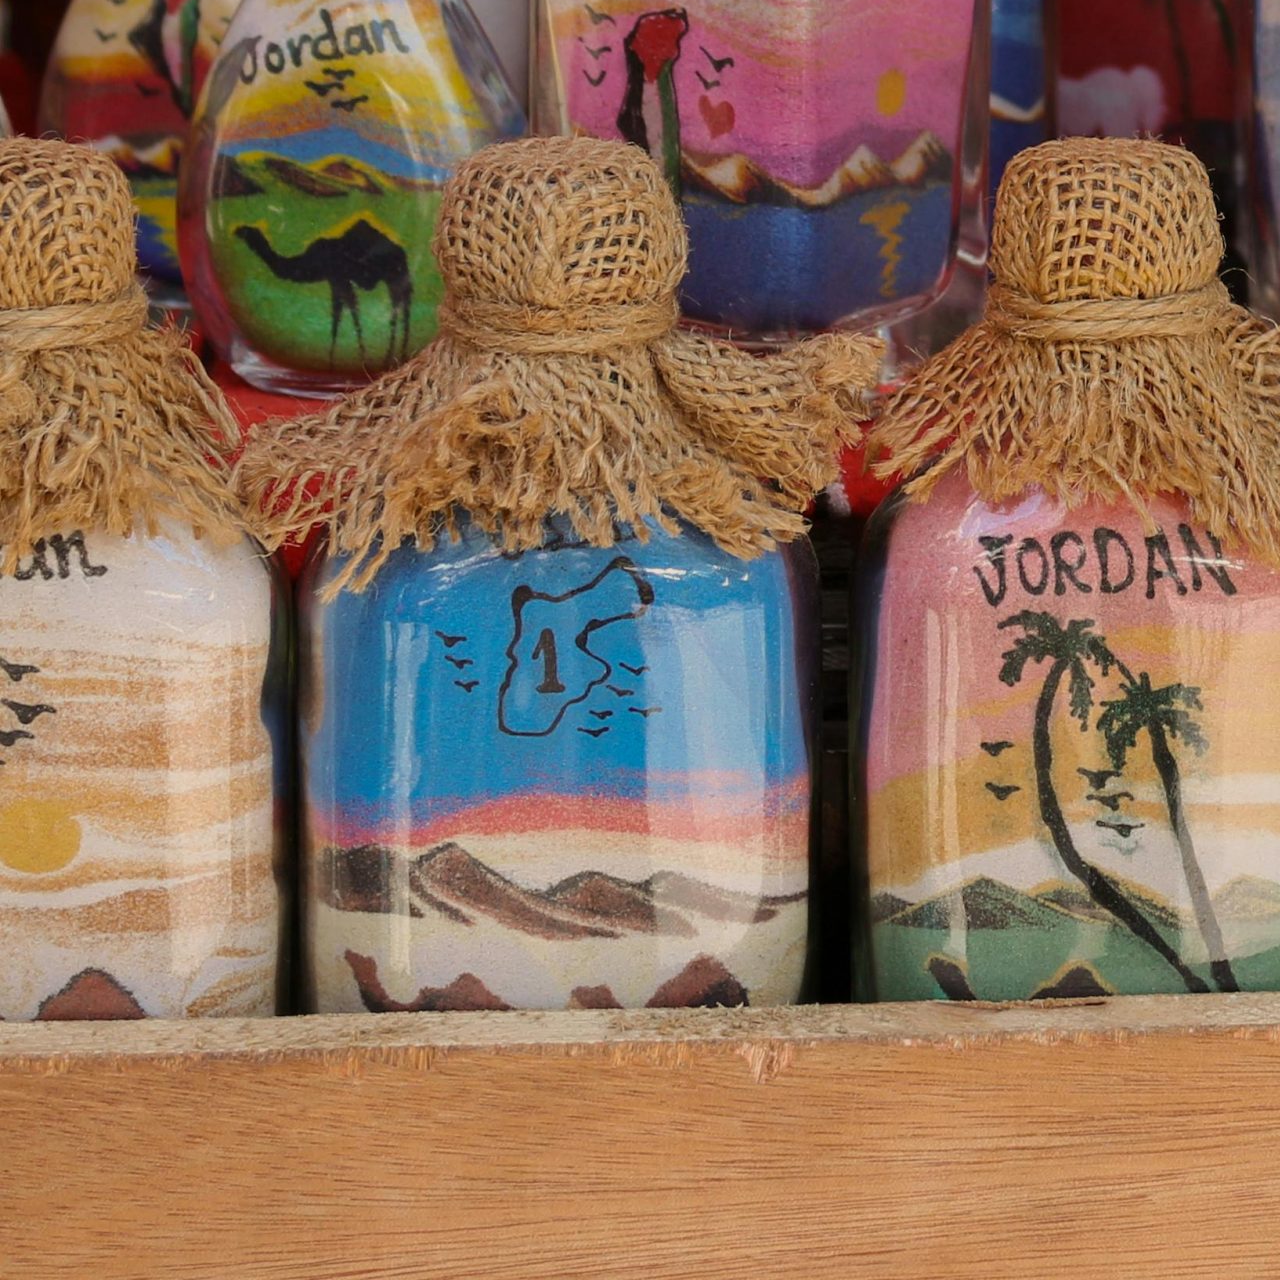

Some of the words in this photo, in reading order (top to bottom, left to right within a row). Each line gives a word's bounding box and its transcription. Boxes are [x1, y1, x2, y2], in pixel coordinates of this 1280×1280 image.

[239, 8, 411, 86] Jordan
[0, 529, 108, 581] an
[973, 522, 1238, 608] JORDAN
[531, 627, 567, 694] 1
